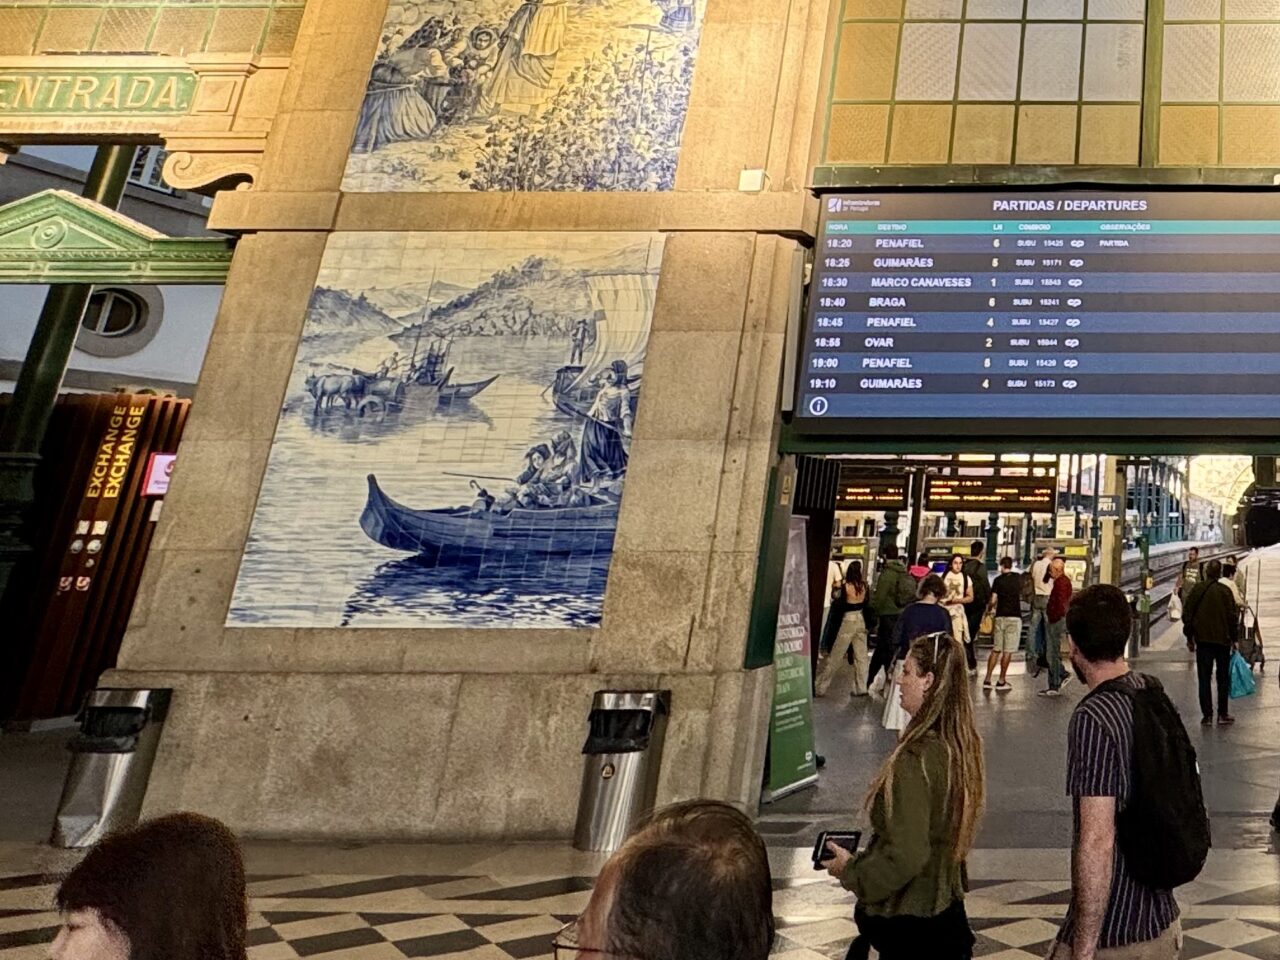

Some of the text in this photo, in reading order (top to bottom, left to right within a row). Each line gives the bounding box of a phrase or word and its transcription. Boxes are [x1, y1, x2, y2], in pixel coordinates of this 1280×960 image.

[992, 200, 1147, 210] PARTIDAS / DEPARTURES
[826, 239, 852, 248] 18:20
[875, 239, 924, 248] PENAFIEL
[824, 258, 850, 267] 18:25
[873, 257, 933, 267] GUIMARÃES
[821, 278, 847, 287] 18:30
[871, 278, 910, 287] MARCO
[912, 278, 971, 287] CANAVESES
[991, 278, 996, 287] 1
[819, 298, 845, 307] 18:40
[868, 298, 905, 307] BRAGA
[817, 318, 843, 327] 18:45
[866, 318, 916, 327] PENAFIEL
[987, 318, 993, 327] 4
[814, 338, 840, 347] 18:55
[864, 338, 893, 347] OVAR
[986, 338, 992, 347] 2
[812, 358, 838, 367] 19:00
[862, 358, 912, 367] PENAFIEL
[809, 379, 836, 388] 19:10
[859, 378, 922, 388] GUIMARÃES
[982, 379, 988, 388] 4
[87, 406, 125, 497] EXCHANGE
[104, 406, 144, 497] EXCHANGE
